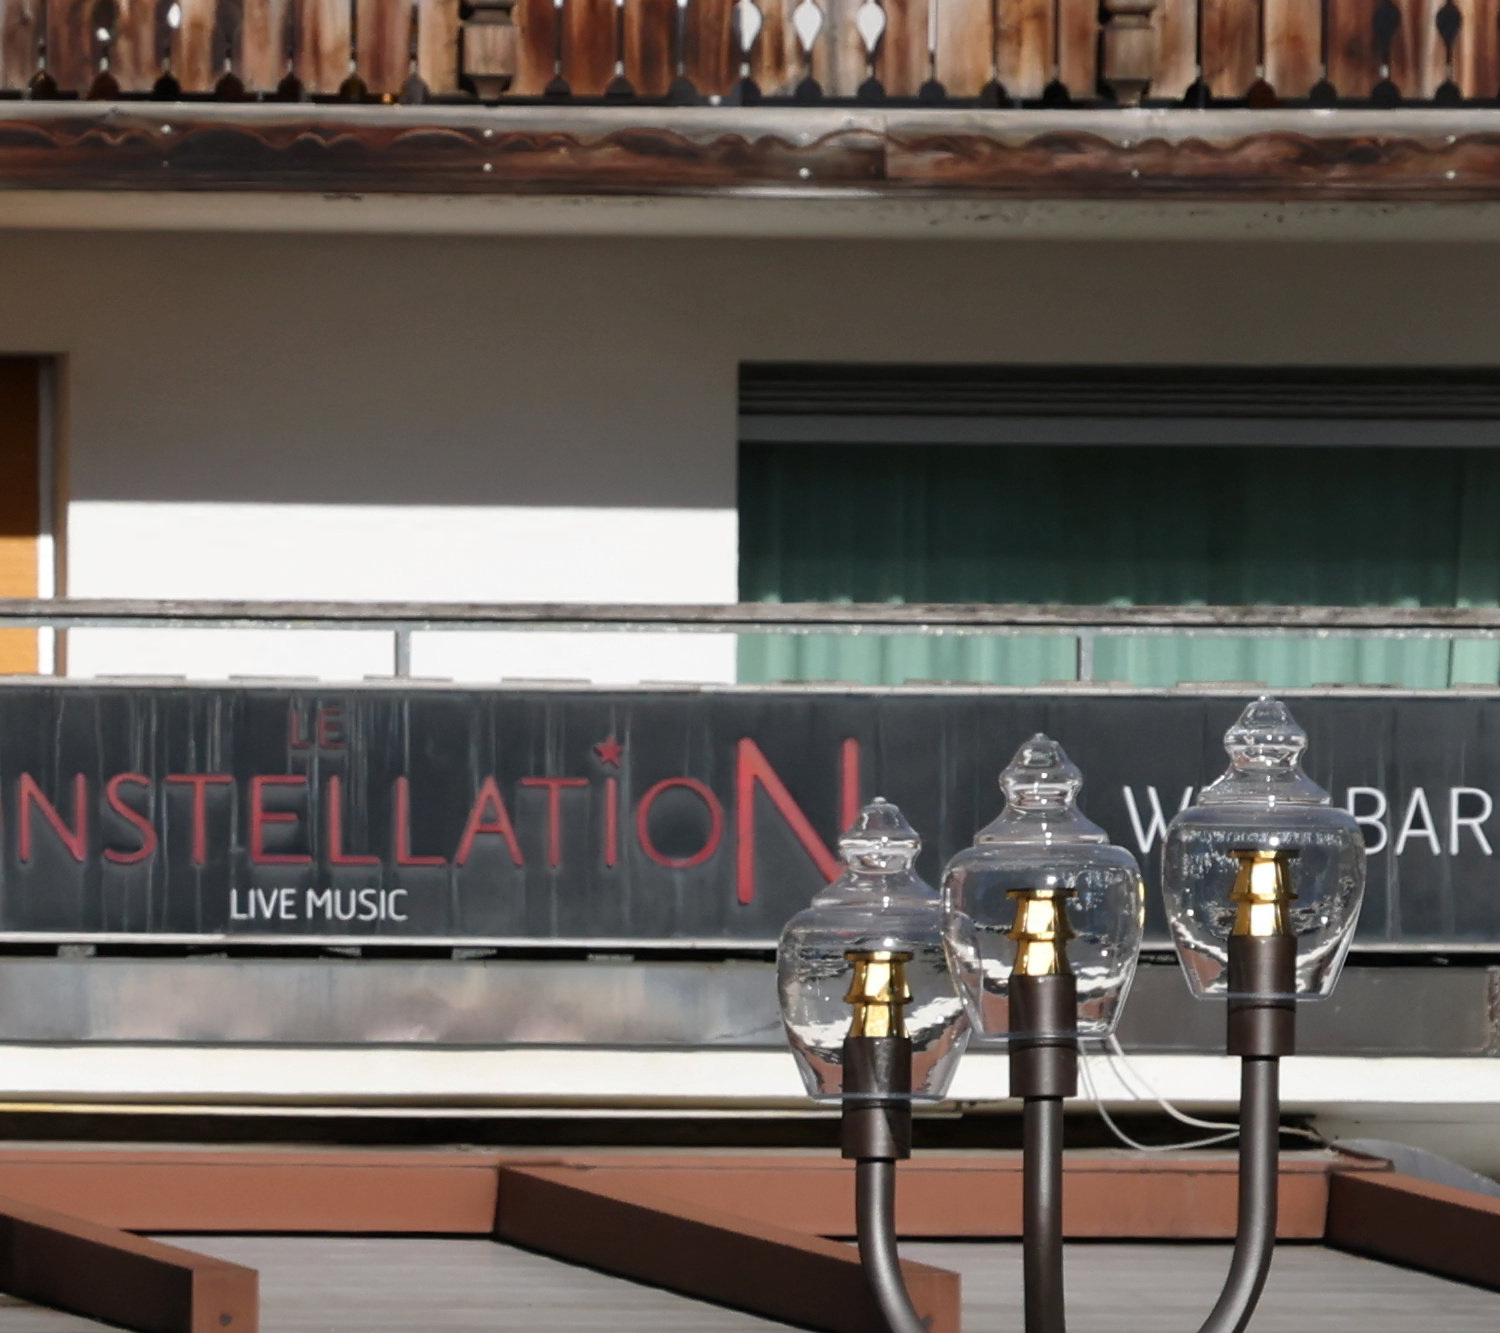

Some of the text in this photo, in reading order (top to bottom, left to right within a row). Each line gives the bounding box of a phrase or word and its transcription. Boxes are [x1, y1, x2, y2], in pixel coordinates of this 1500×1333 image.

[289, 708, 346, 748] LE
[1343, 786, 1494, 856] BAR
[230, 887, 409, 921] LIVE MUSIC
